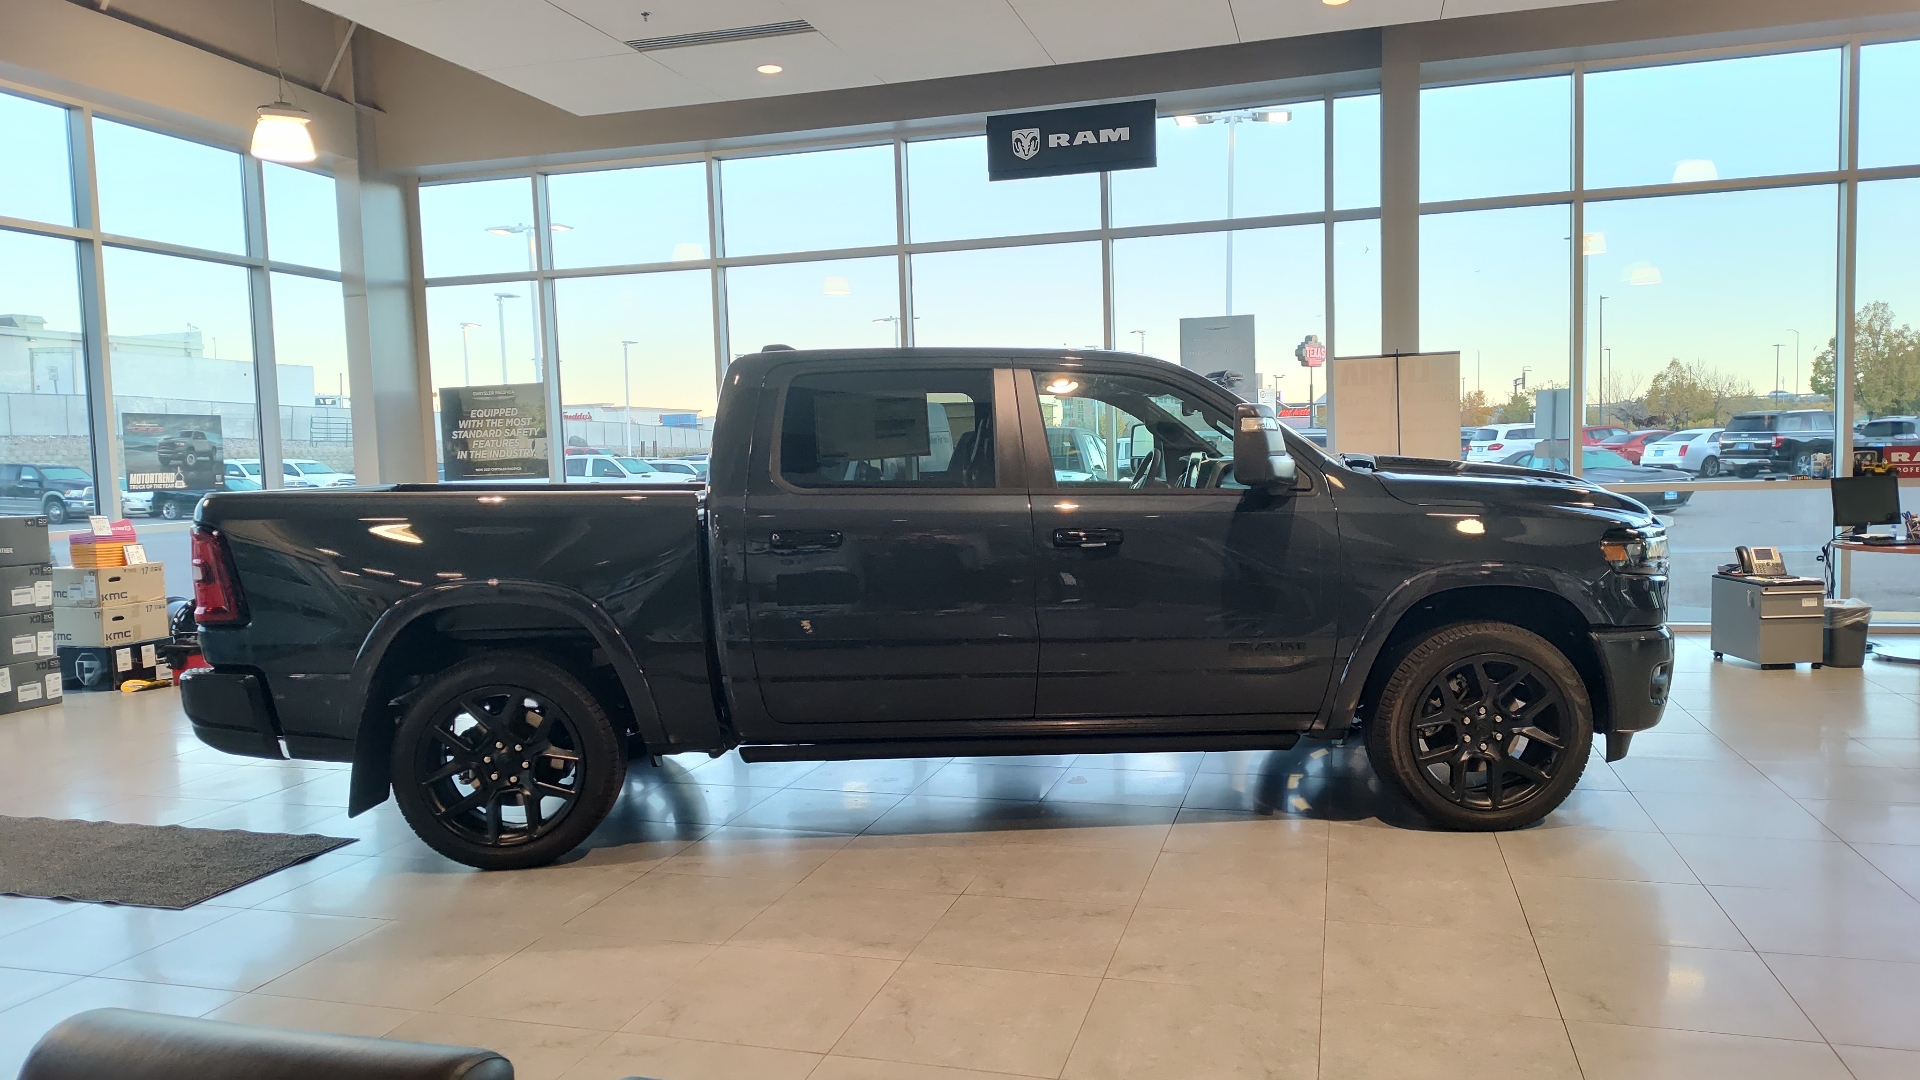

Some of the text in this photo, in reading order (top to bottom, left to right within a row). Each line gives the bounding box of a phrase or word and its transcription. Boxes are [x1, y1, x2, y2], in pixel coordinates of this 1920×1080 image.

[1048, 126, 1130, 148] RAM
[1305, 346, 1326, 359] TEXAS
[470, 407, 518, 418] EQUIPPED
[458, 417, 533, 429] WITH THE MOST
[451, 427, 540, 439] STANDARD SAFETY
[472, 439, 520, 449] FEATURES
[456, 448, 537, 460] IN THE INDUSTRY.
[129, 472, 176, 484] MOTORTREND
[141, 566, 149, 575] 17
[145, 604, 153, 613] 17
[93, 611, 100, 619] 17
